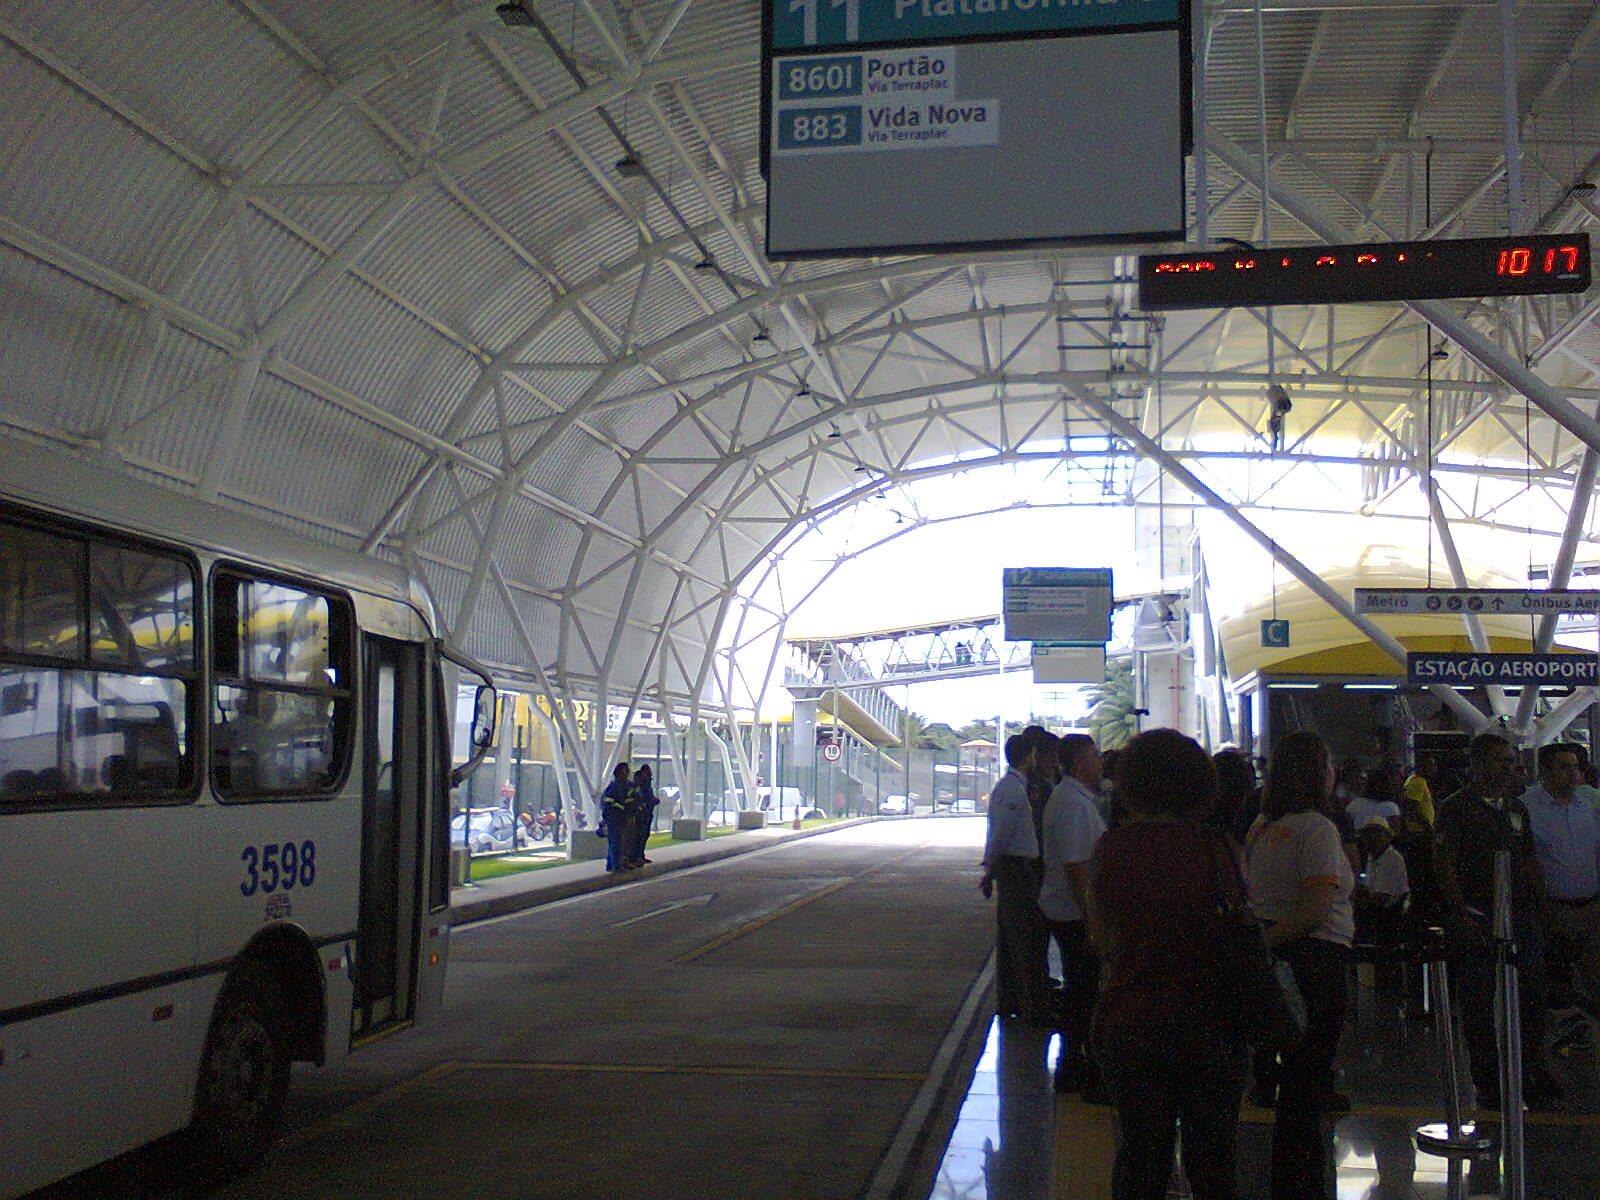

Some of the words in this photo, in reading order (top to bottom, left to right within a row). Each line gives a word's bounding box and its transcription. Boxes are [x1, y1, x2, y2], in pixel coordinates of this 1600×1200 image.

[789, 0, 860, 45] 11
[895, 0, 1118, 19] Plata
[867, 55, 946, 79] Portão
[793, 113, 848, 141] 883
[868, 105, 921, 129] Vida
[927, 104, 988, 125] Nova
[1268, 622, 1281, 643] C
[1415, 657, 1495, 681] ESTAÇÃO
[1500, 661, 1600, 678] AEROPORT
[240, 840, 316, 897] 3598
